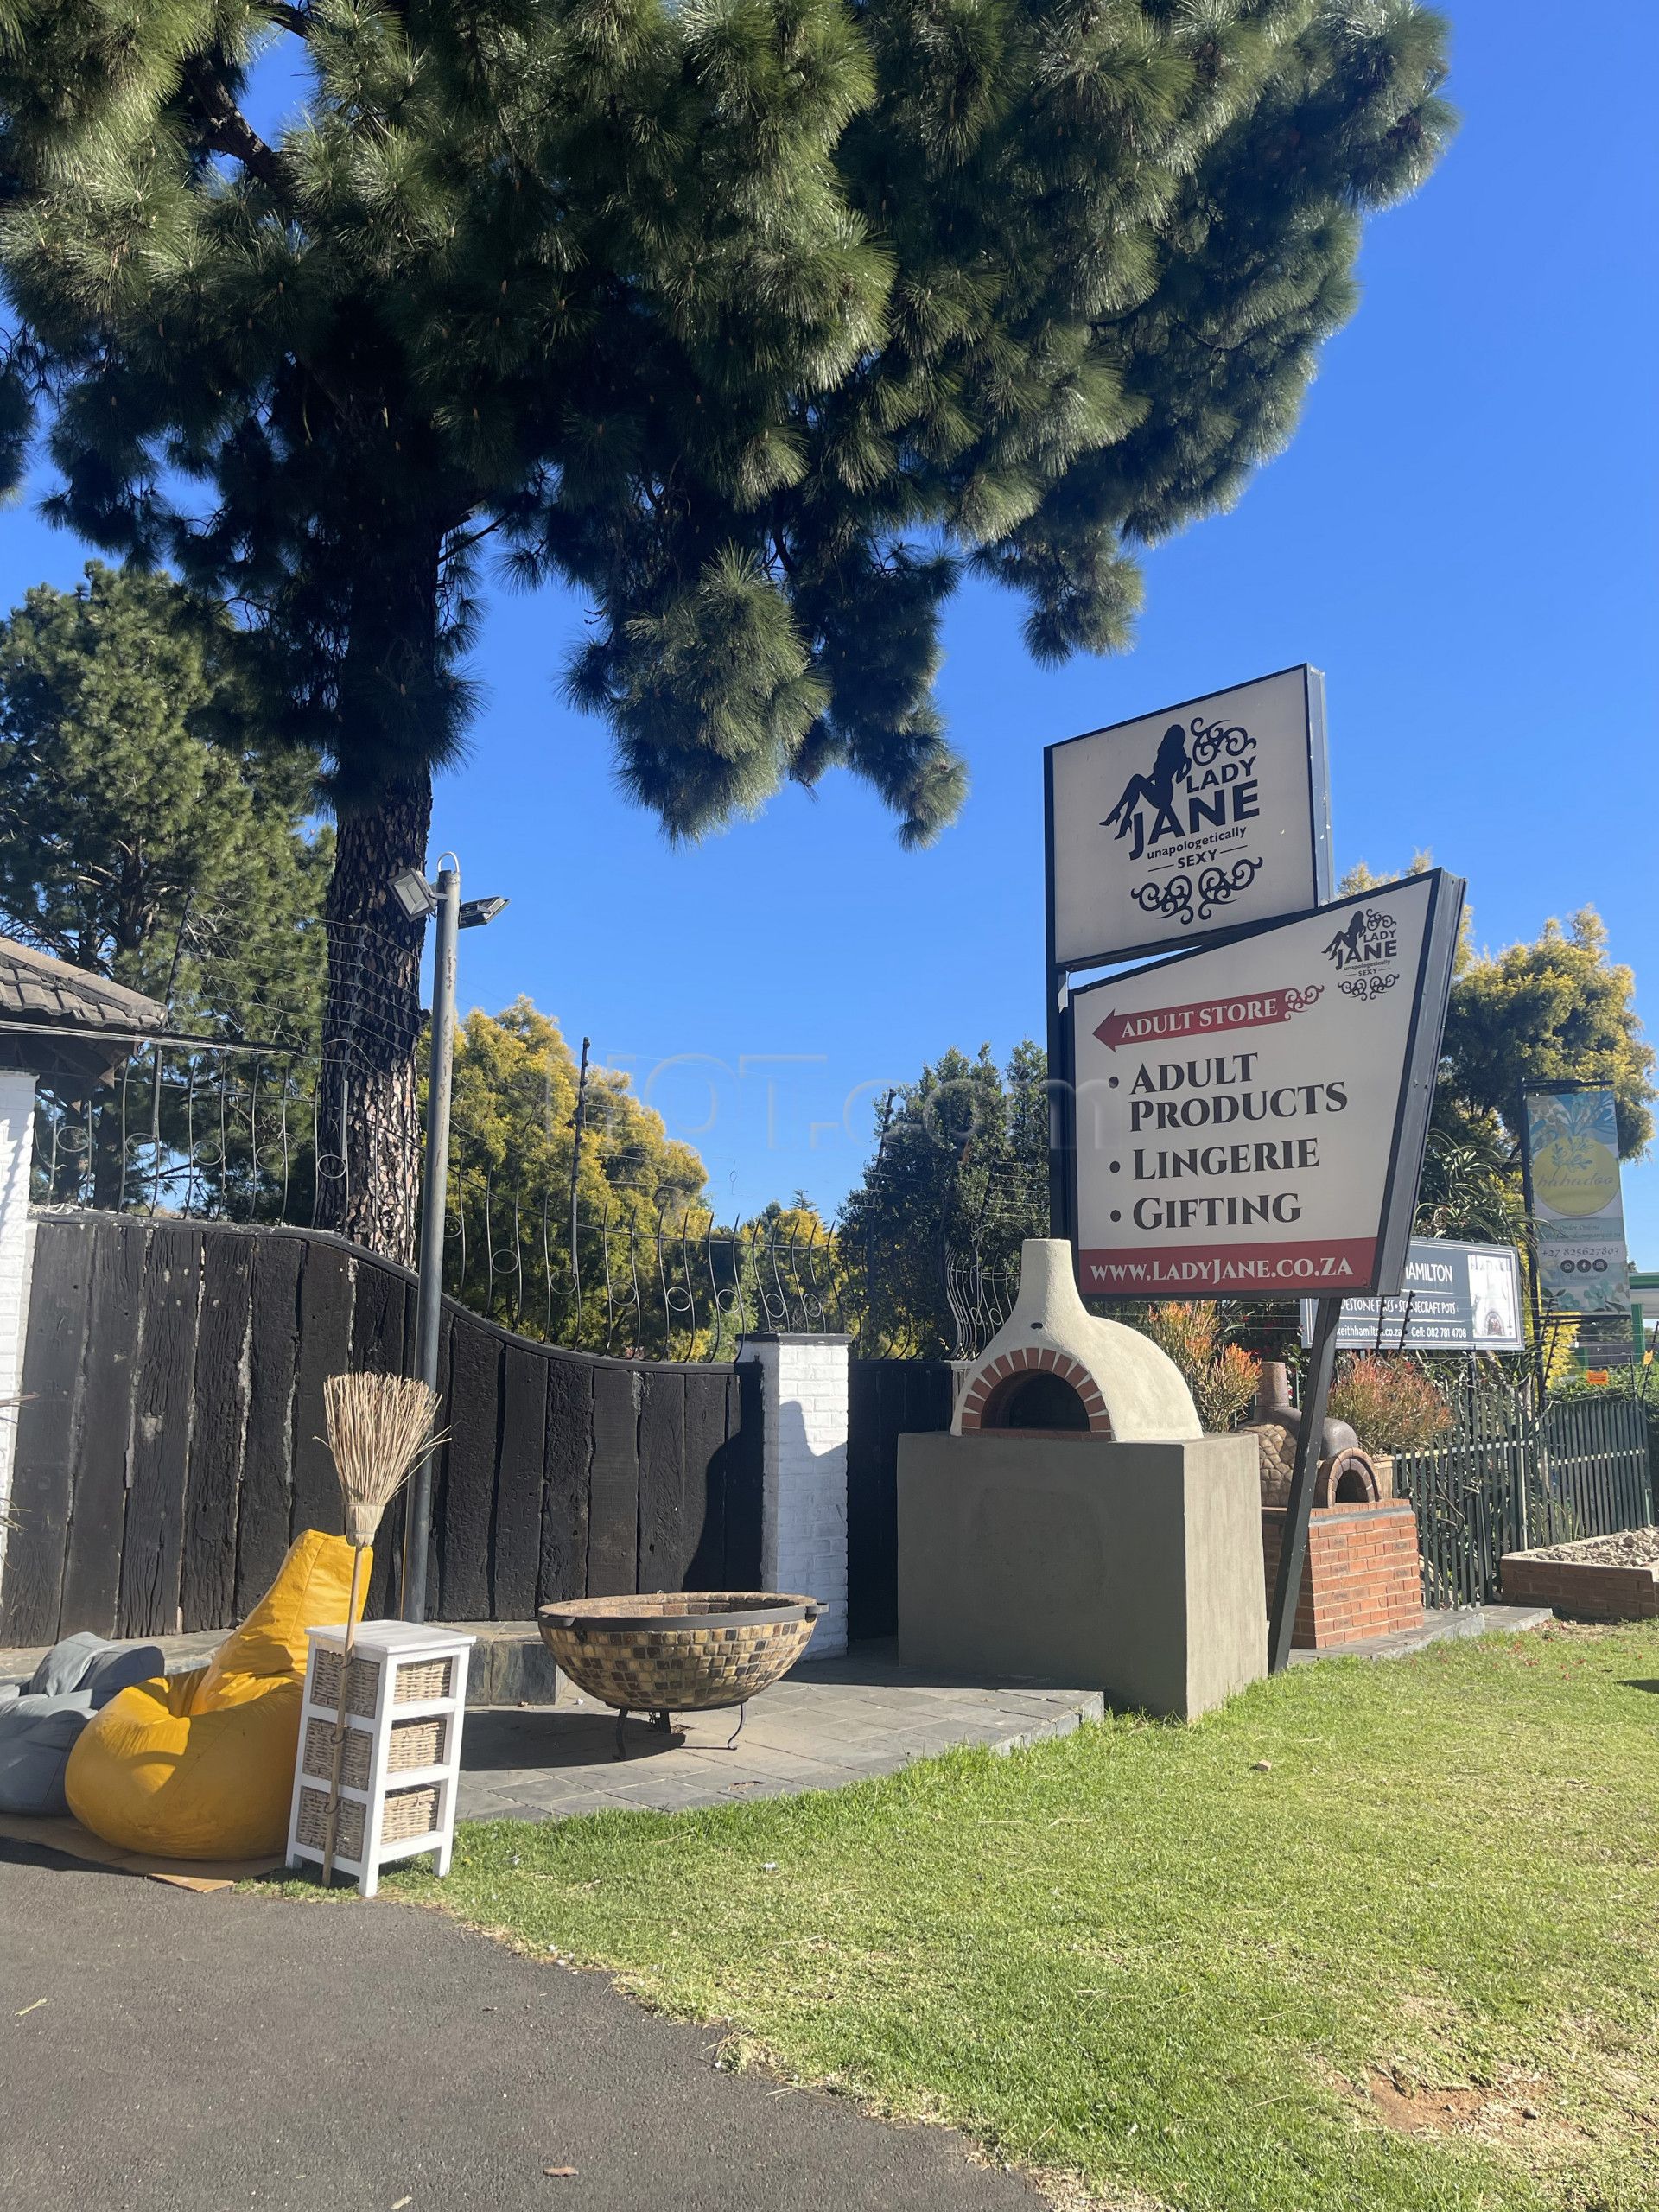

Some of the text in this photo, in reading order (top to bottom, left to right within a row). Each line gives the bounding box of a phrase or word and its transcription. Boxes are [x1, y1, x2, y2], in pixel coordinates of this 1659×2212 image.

[1186, 755, 1257, 794] LADY
[1128, 779, 1261, 861] JANE
[1147, 826, 1247, 860] unapologetically
[1177, 848, 1218, 870] SEXY
[1363, 929, 1397, 943] LADY
[1335, 939, 1397, 971] JANE
[1343, 959, 1391, 971] unapologetically
[1357, 968, 1378, 976] SEXY
[1121, 997, 1279, 1039] ADULT STORE
[1128, 1052, 1258, 1096] ADULT
[1128, 1082, 1348, 1132] PRODUCTS
[1133, 1137, 1321, 1181] LINGERIE
[1132, 1192, 1302, 1230] GIFTING
[1541, 1249, 1560, 1258] +27
[1376, 1299, 1395, 1313] FRES
[1440, 1301, 1456, 1314] POTS
[1411, 1327, 1426, 1338] Cell:
[1427, 1327, 1439, 1338] 082
[1440, 1327, 1450, 1338] 781
[1451, 1328, 1467, 1338] 4708
